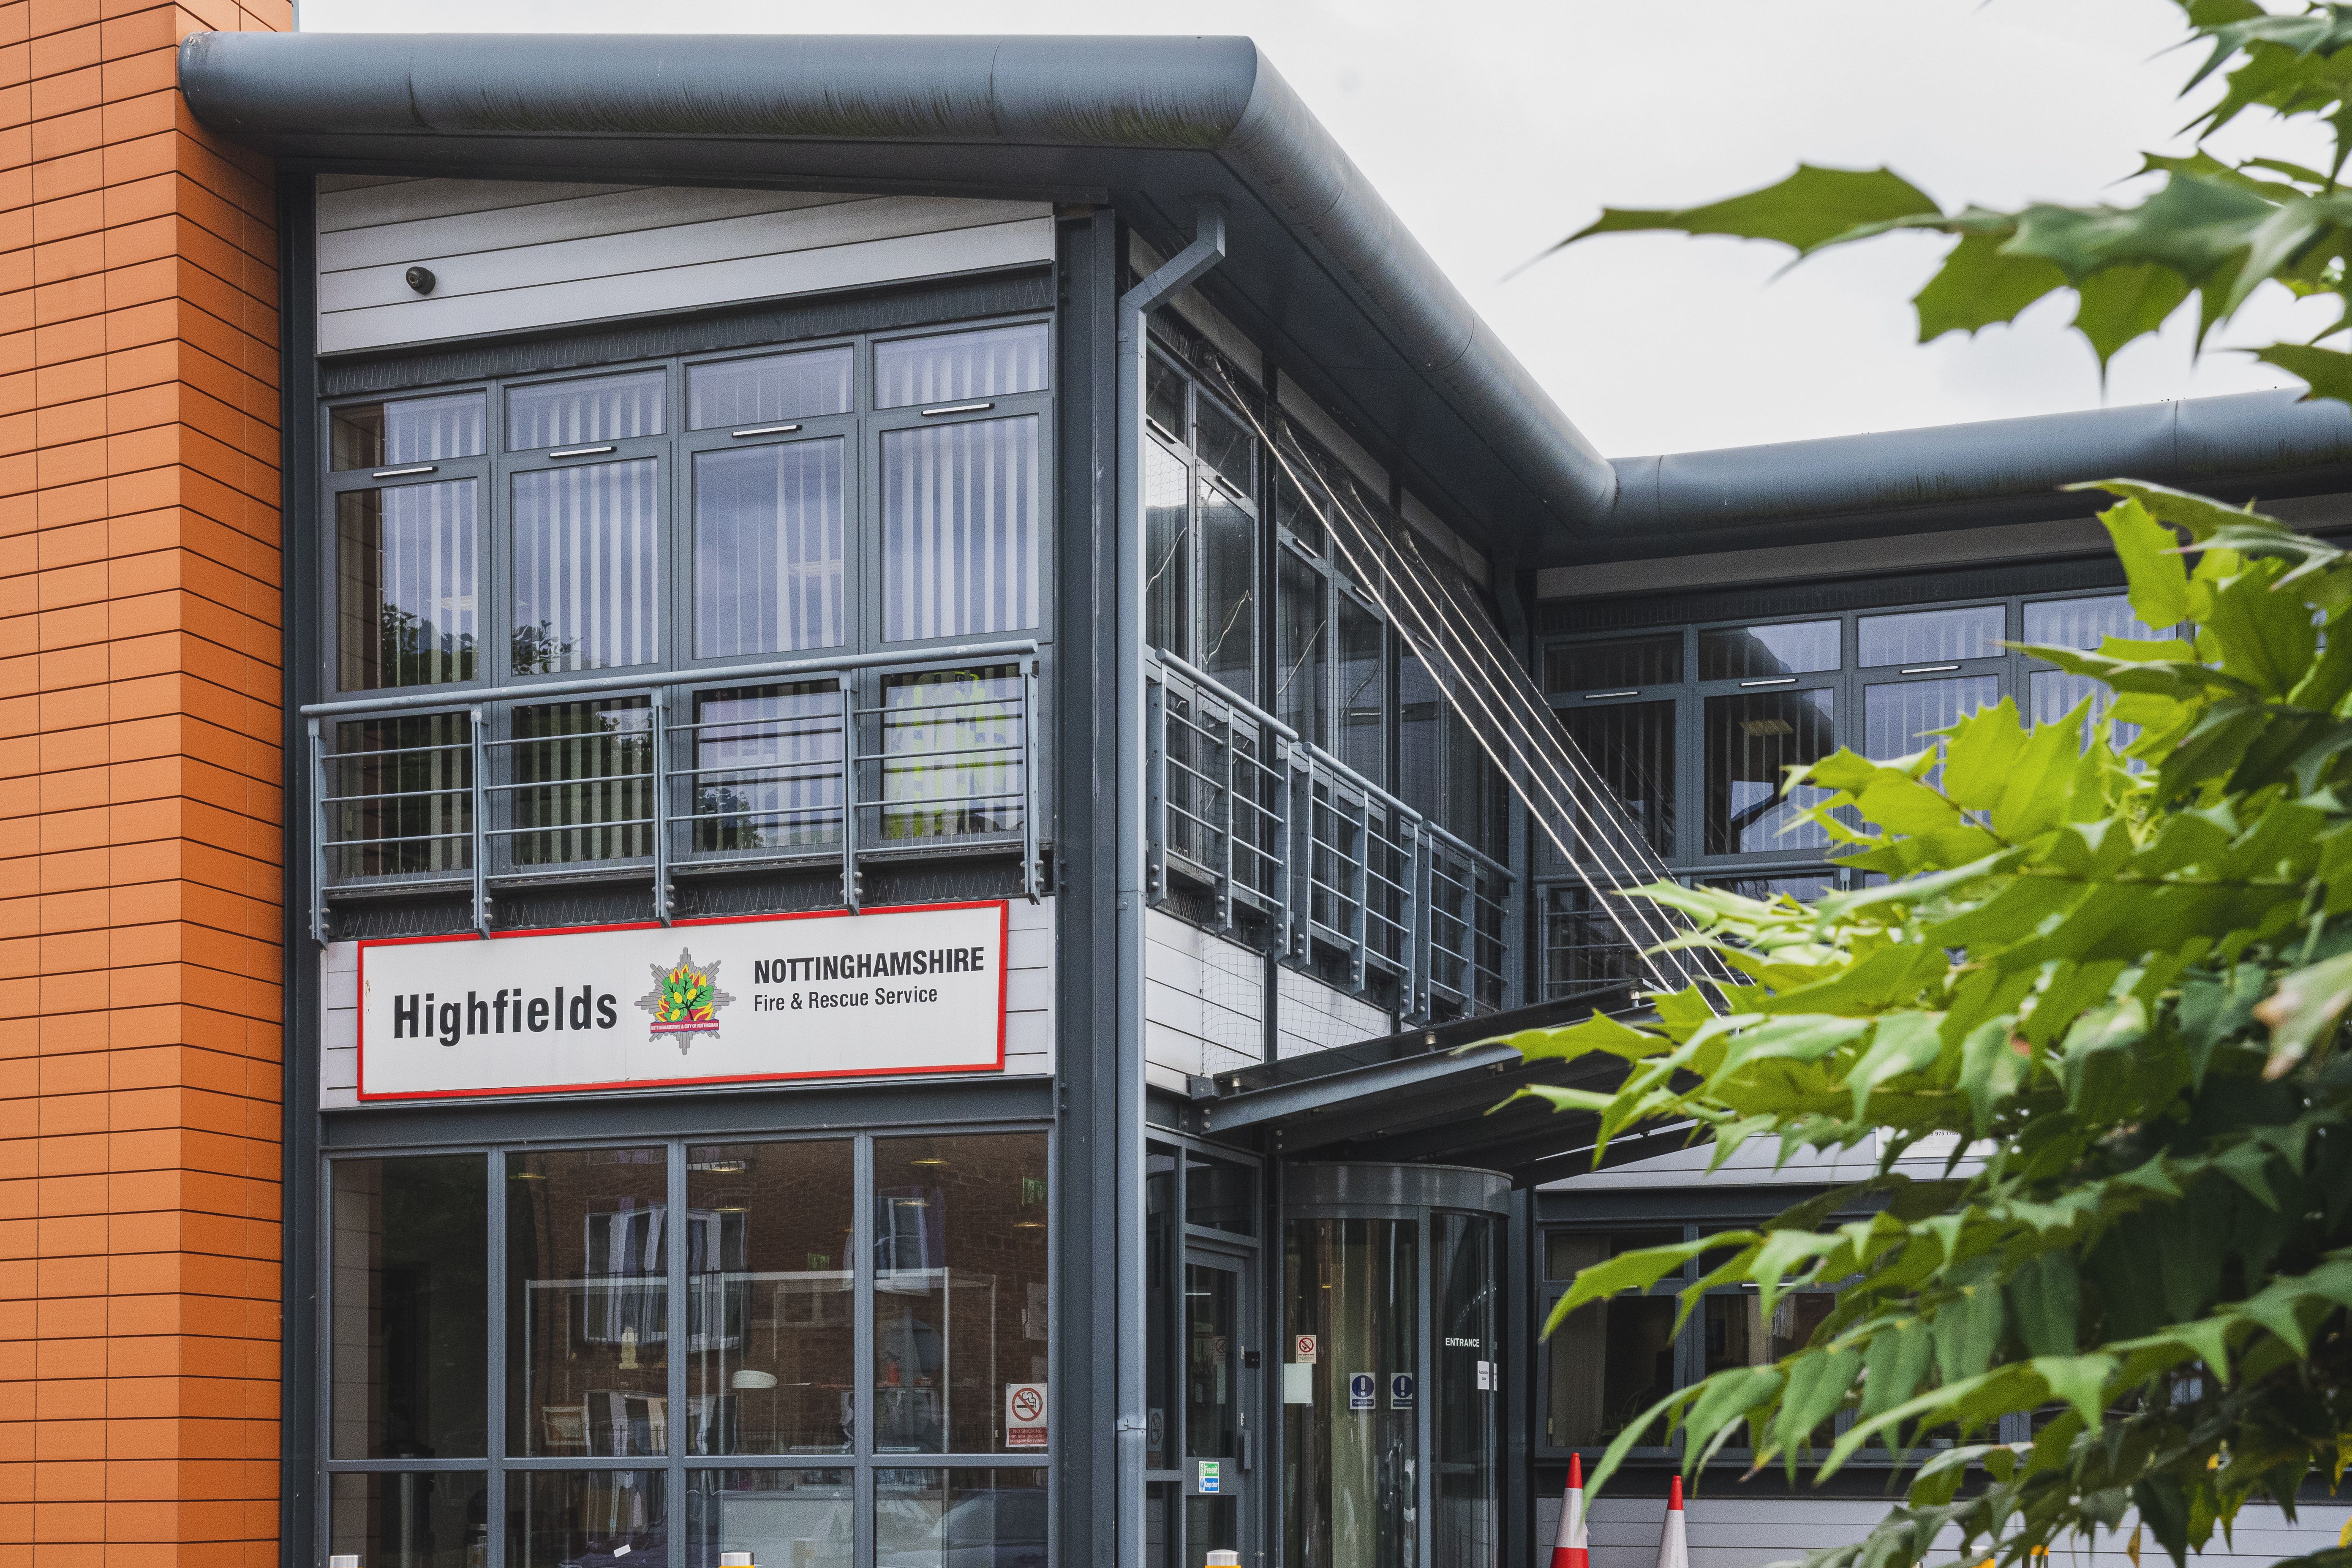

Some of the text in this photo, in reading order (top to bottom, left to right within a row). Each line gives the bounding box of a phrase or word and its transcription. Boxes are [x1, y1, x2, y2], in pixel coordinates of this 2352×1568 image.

[754, 947, 984, 984] NOTTINGHAMSHIRE
[754, 985, 938, 1011] Fire & Rescue Service
[394, 985, 618, 1047] Highfields
[1446, 1337, 1480, 1347] ENTRANCE
